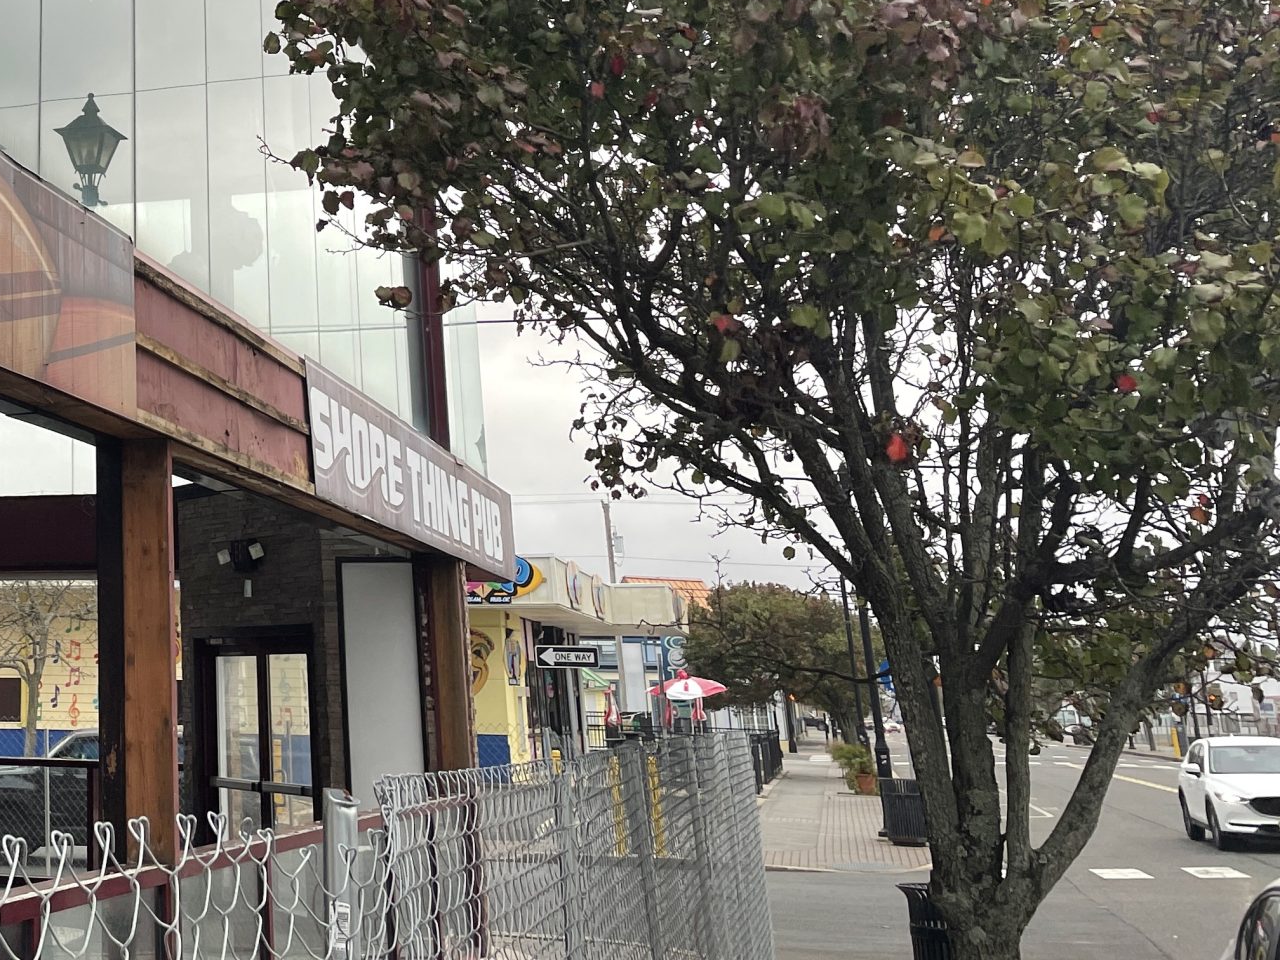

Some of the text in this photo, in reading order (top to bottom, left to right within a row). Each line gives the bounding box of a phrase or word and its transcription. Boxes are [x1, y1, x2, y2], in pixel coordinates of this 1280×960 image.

[310, 386, 504, 562] SHORE THING PUB
[554, 652, 592, 662] ONE WAY
